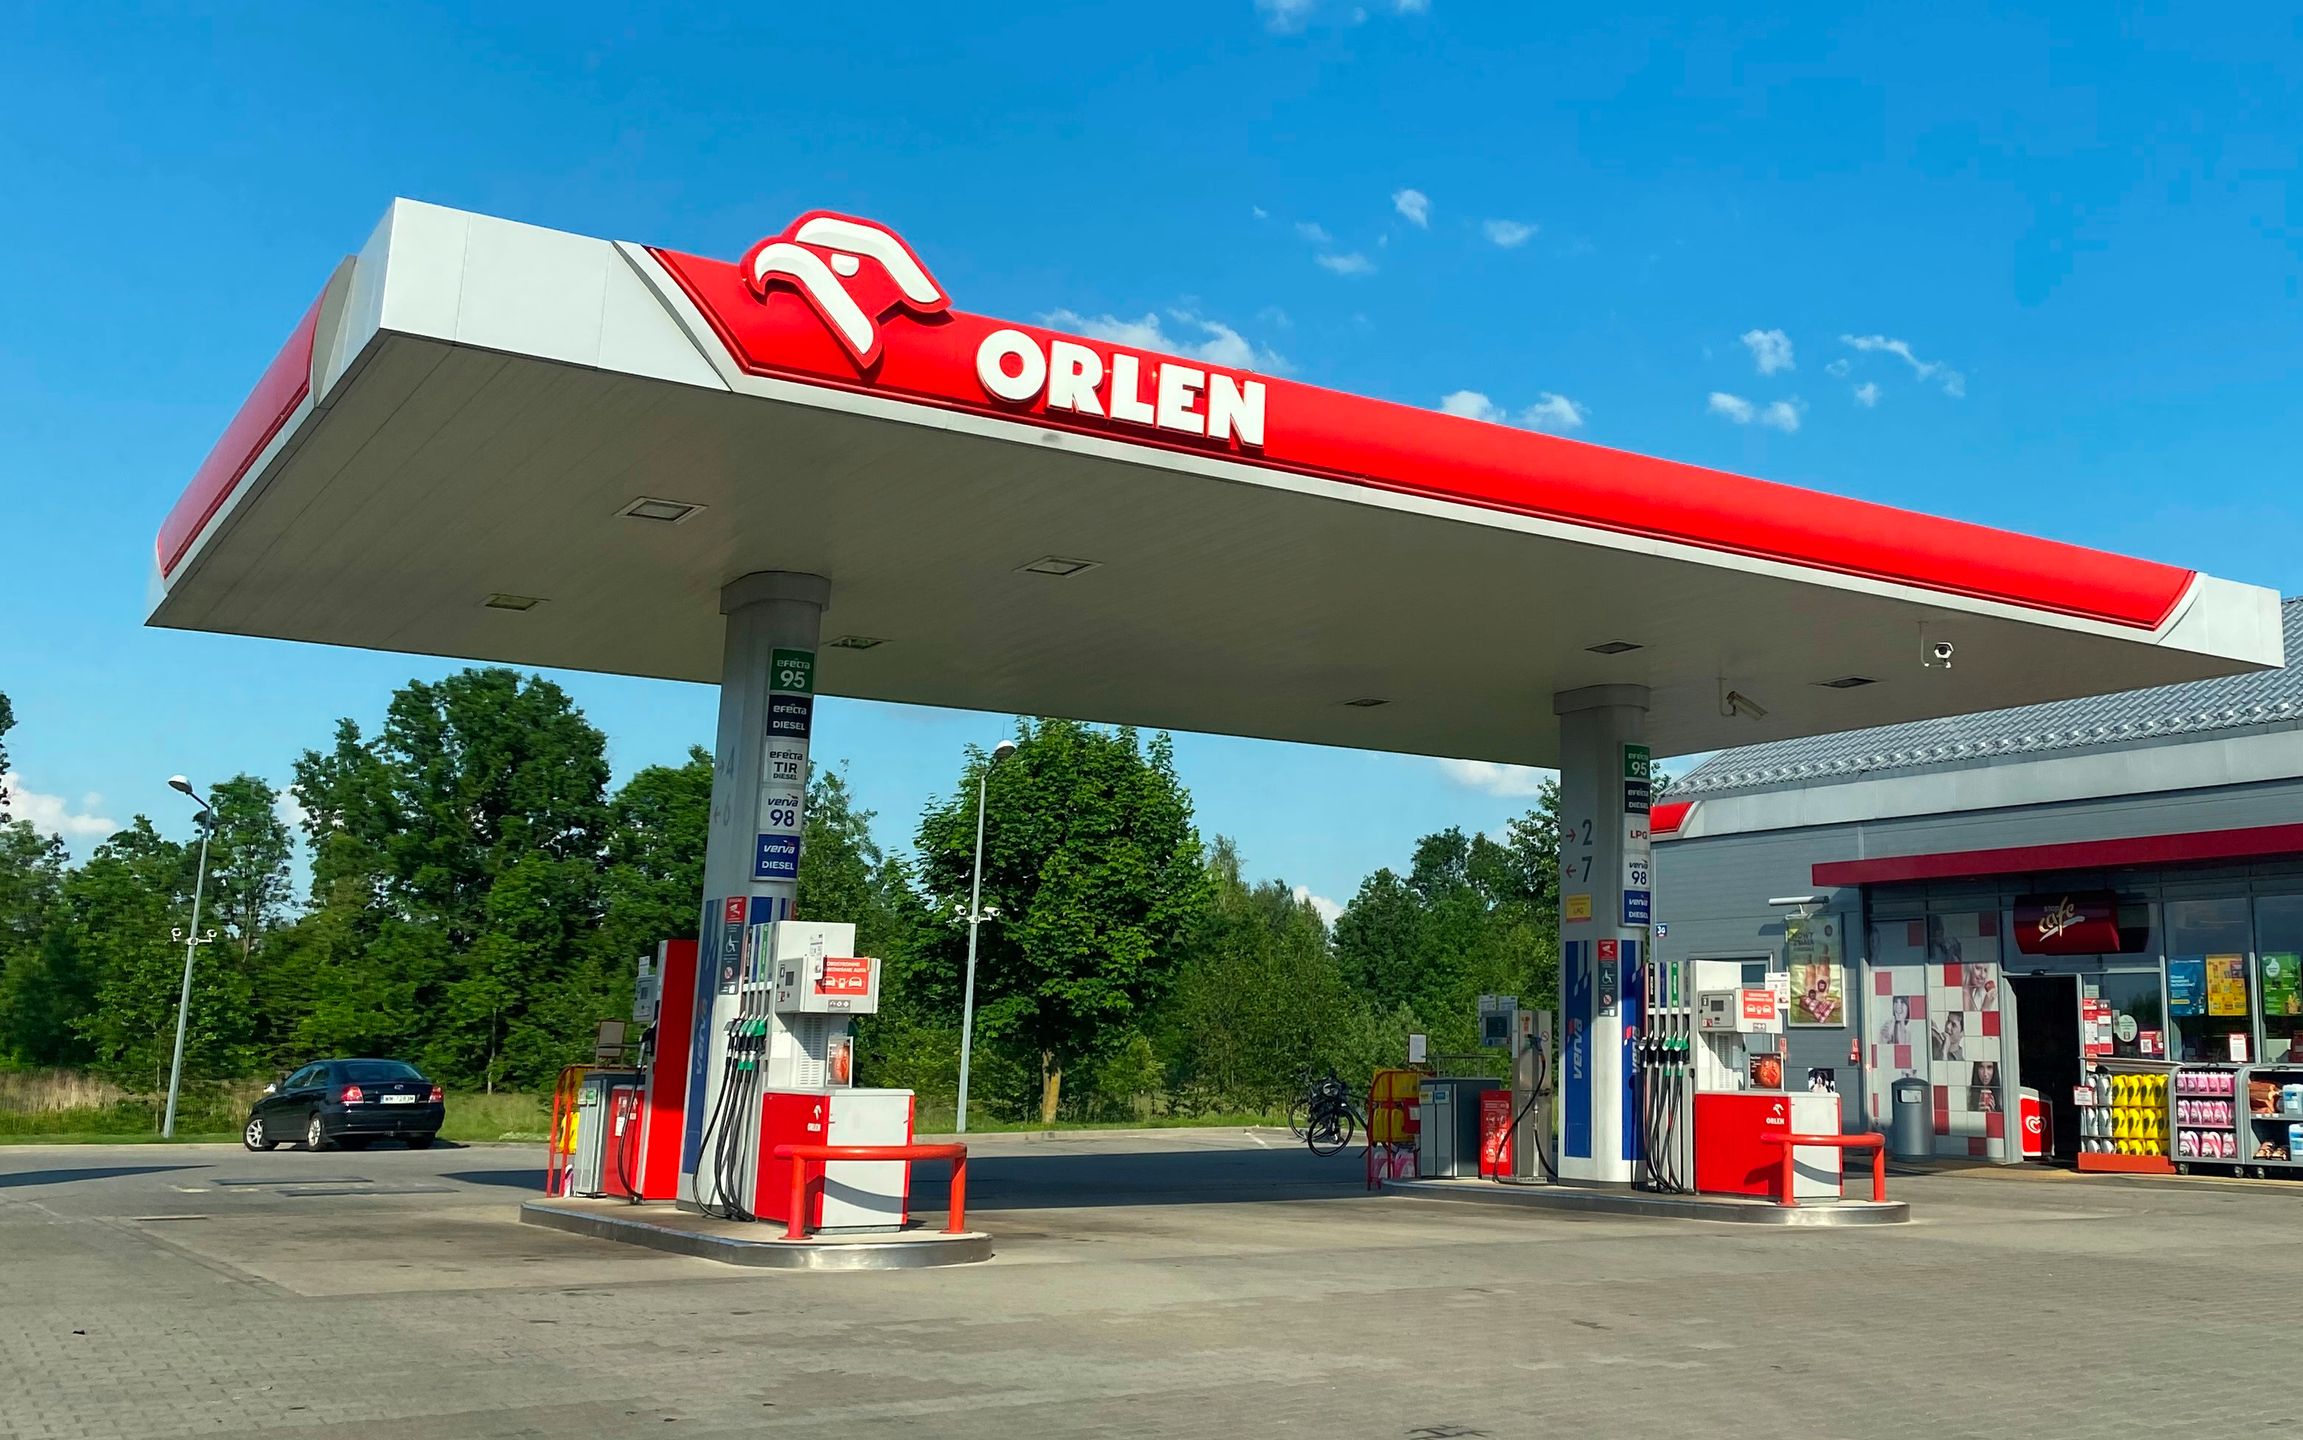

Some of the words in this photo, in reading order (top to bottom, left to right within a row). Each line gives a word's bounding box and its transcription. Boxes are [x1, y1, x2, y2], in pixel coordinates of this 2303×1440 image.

[976, 329, 1266, 446] ORLEN
[780, 670, 805, 688] 95
[772, 720, 806, 731] DIESEL
[773, 761, 797, 774] TIR
[1631, 761, 1647, 776] 95
[773, 773, 798, 781] DIESEL
[768, 797, 799, 807] verva
[770, 808, 795, 827] 98
[1582, 819, 1593, 846] 2
[1630, 830, 1648, 840] LPG
[763, 844, 796, 854] verva
[761, 860, 795, 870] DIESEL
[1582, 856, 1593, 883] 7
[1631, 870, 1647, 885] 98
[1573, 1018, 1583, 1079] verva
[1766, 1117, 1785, 1125] ORLEN
